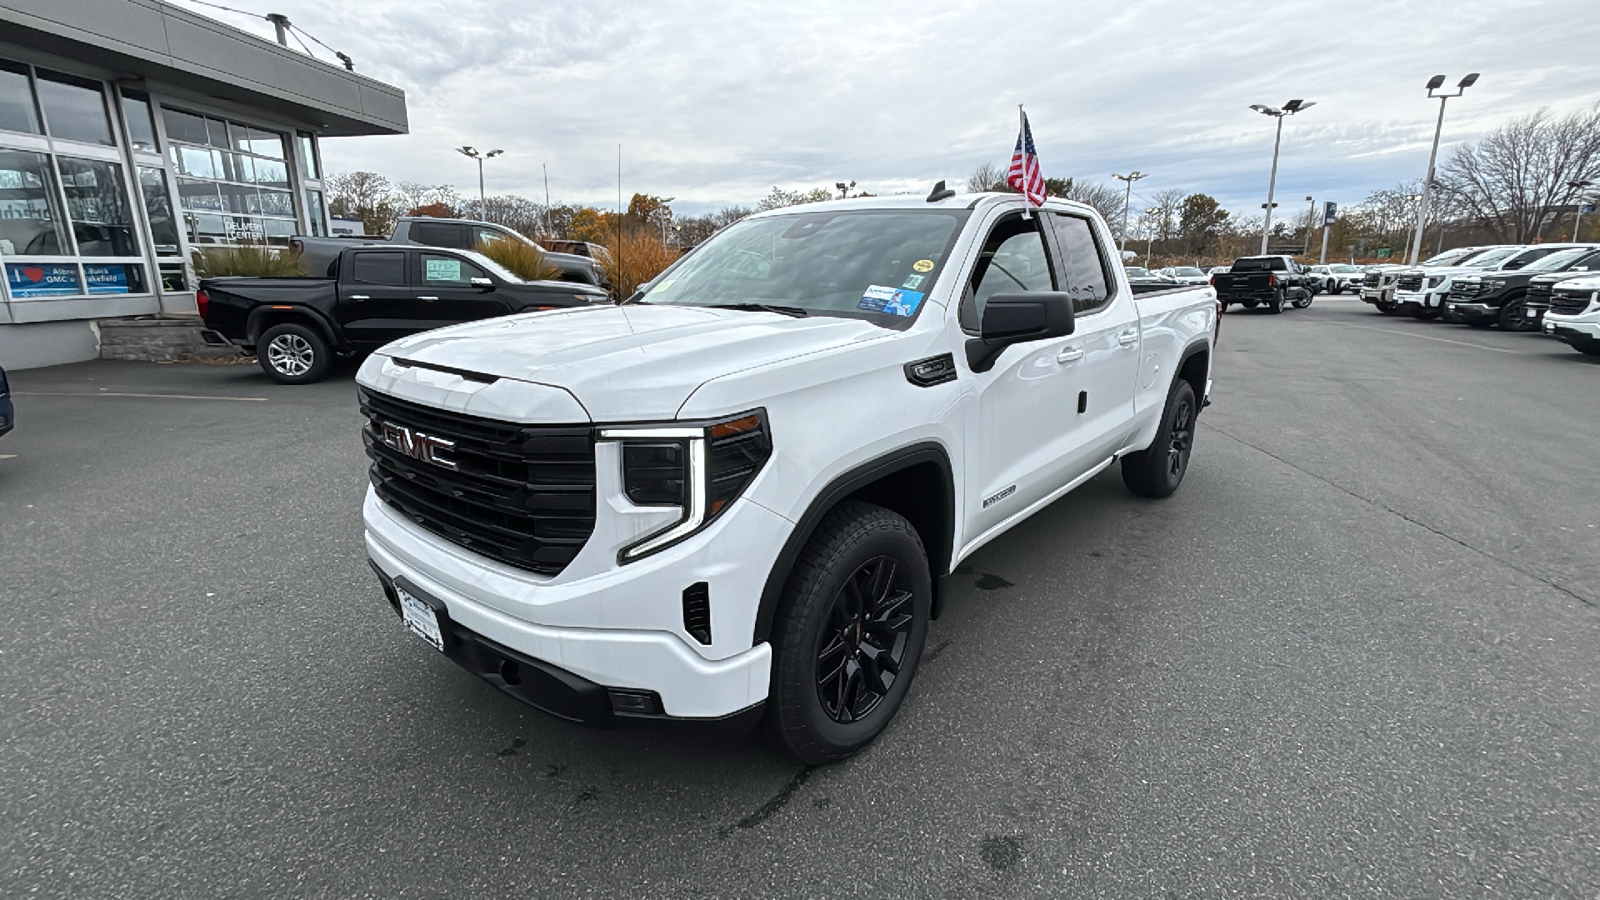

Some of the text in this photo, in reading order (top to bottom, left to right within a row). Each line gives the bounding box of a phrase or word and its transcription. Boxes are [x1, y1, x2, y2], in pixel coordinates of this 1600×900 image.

[225, 221, 263, 231] DELIVERY
[231, 231, 262, 240] CENTER
[88, 267, 109, 275] Buick
[46, 275, 68, 283] GMC
[382, 421, 459, 472] GMC
